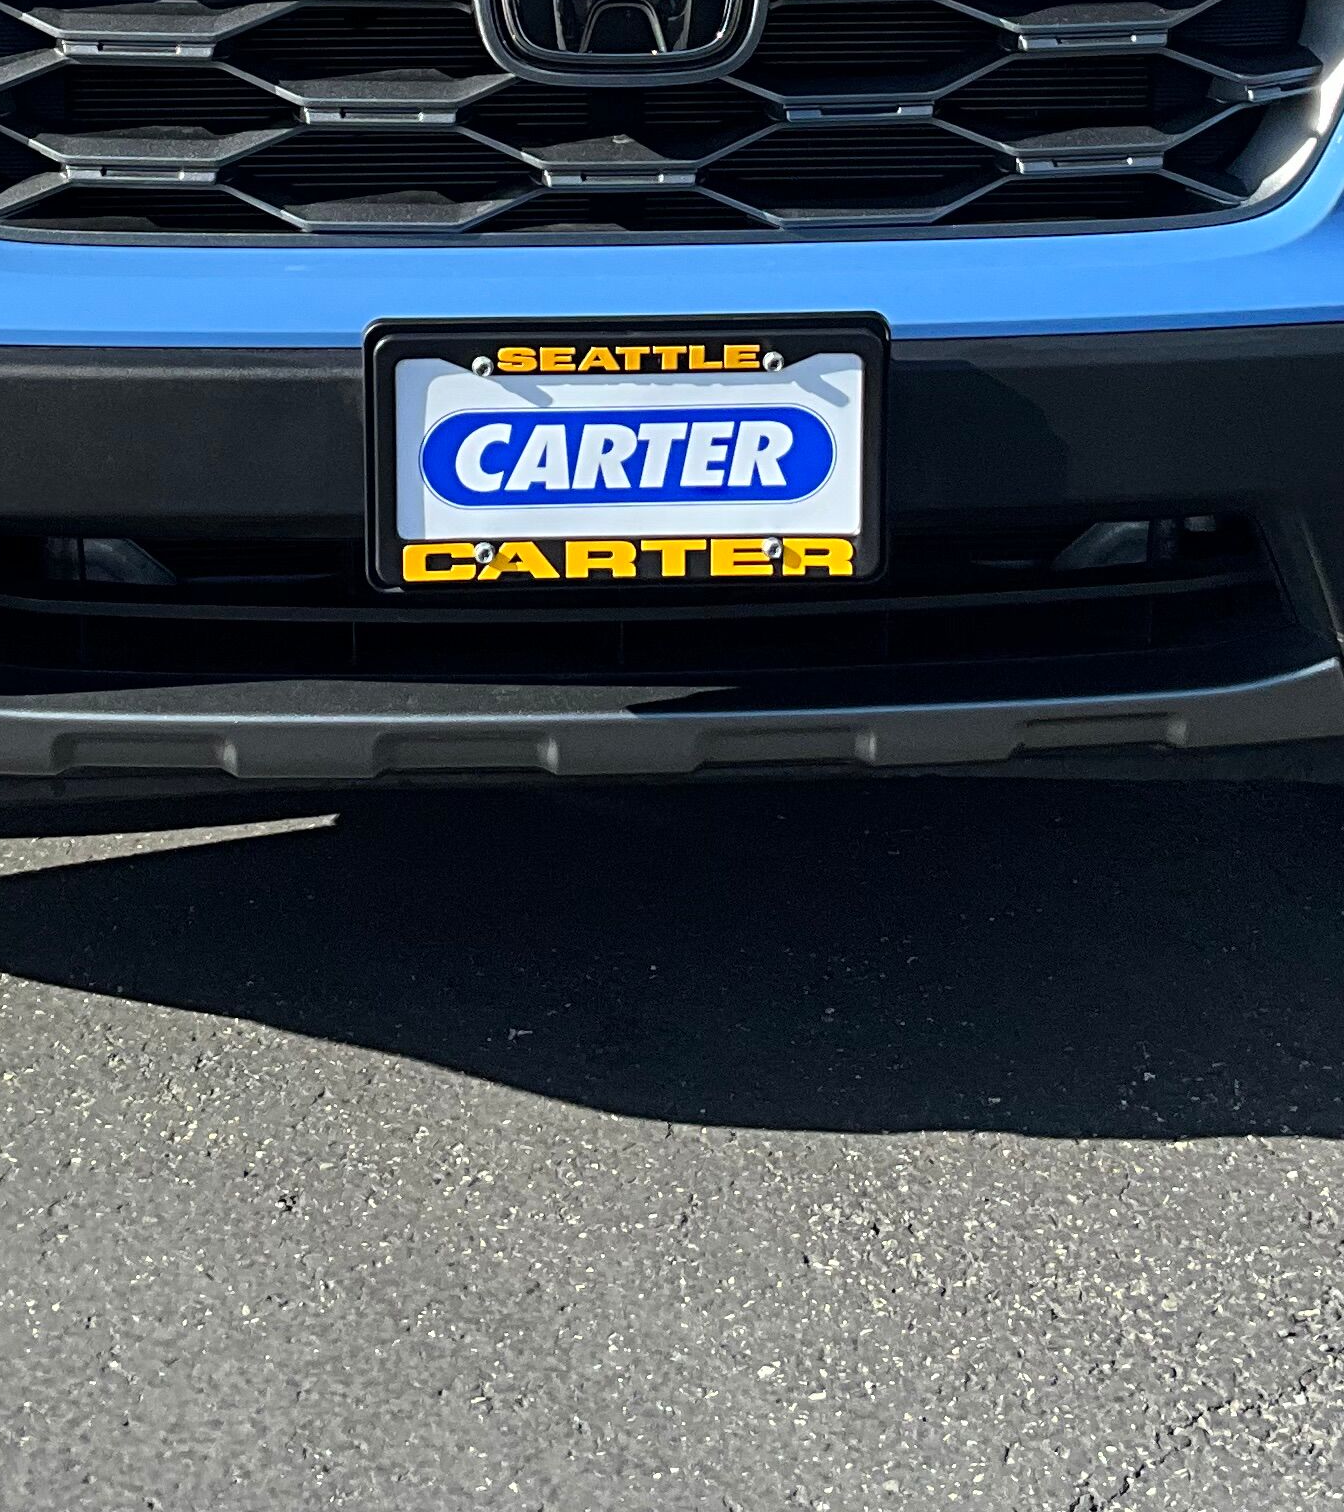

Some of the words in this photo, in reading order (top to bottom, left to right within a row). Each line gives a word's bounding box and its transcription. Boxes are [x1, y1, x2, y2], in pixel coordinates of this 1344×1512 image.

[497, 344, 761, 372] SEATTLE
[455, 420, 794, 492] CARTER
[402, 538, 854, 582] CARTER
